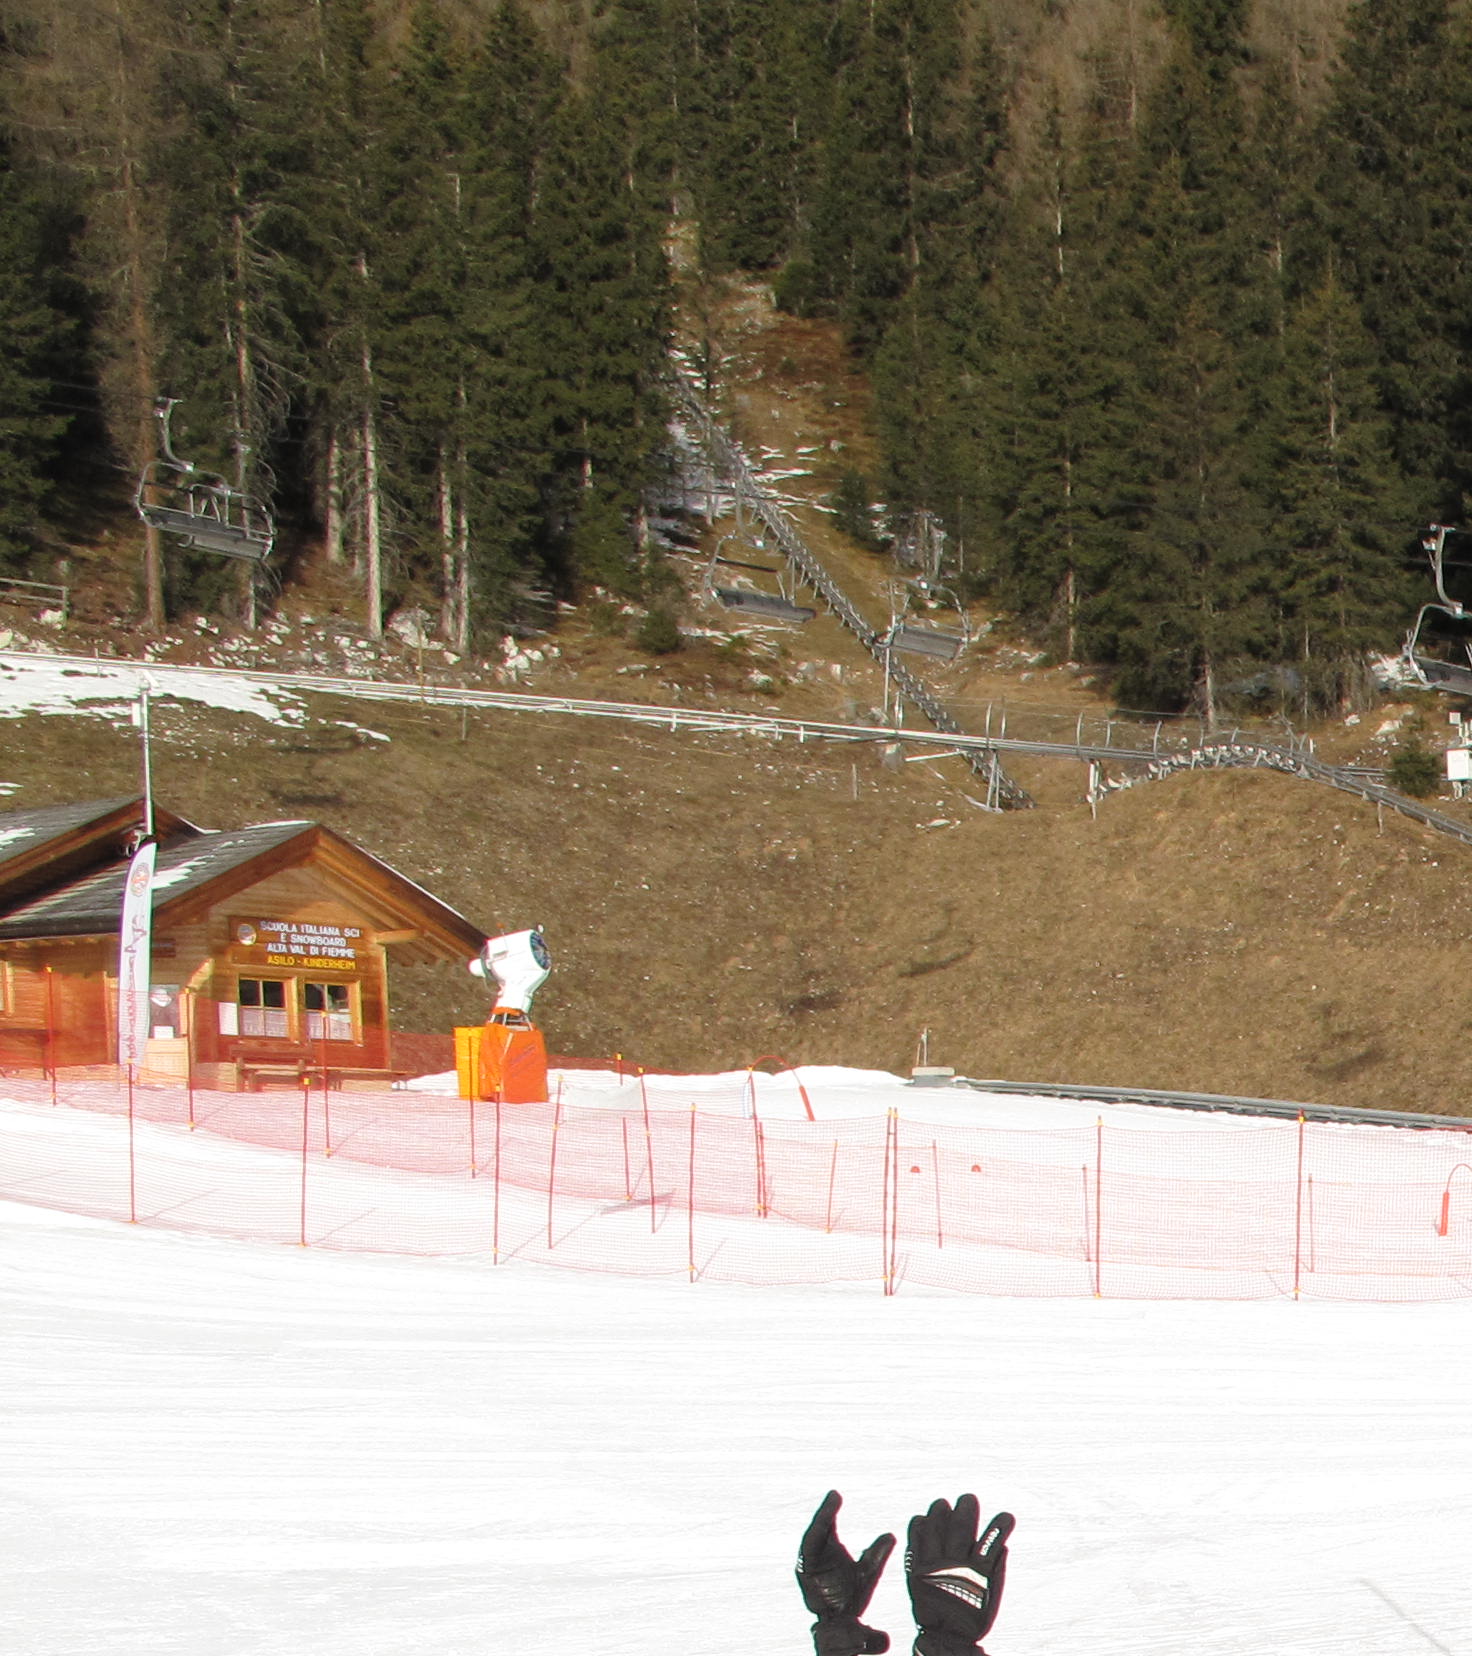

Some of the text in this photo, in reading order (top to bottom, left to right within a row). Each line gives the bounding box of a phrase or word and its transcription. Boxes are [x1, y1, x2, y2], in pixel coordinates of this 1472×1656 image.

[260, 921, 360, 938] SCUOLA ITALIANA SCI
[280, 933, 346, 947] E SNOWBOARD
[266, 943, 355, 958] ALTA VAL DI FIEMME
[267, 955, 295, 966] ASILO
[303, 958, 356, 970] KINDERHEIM
